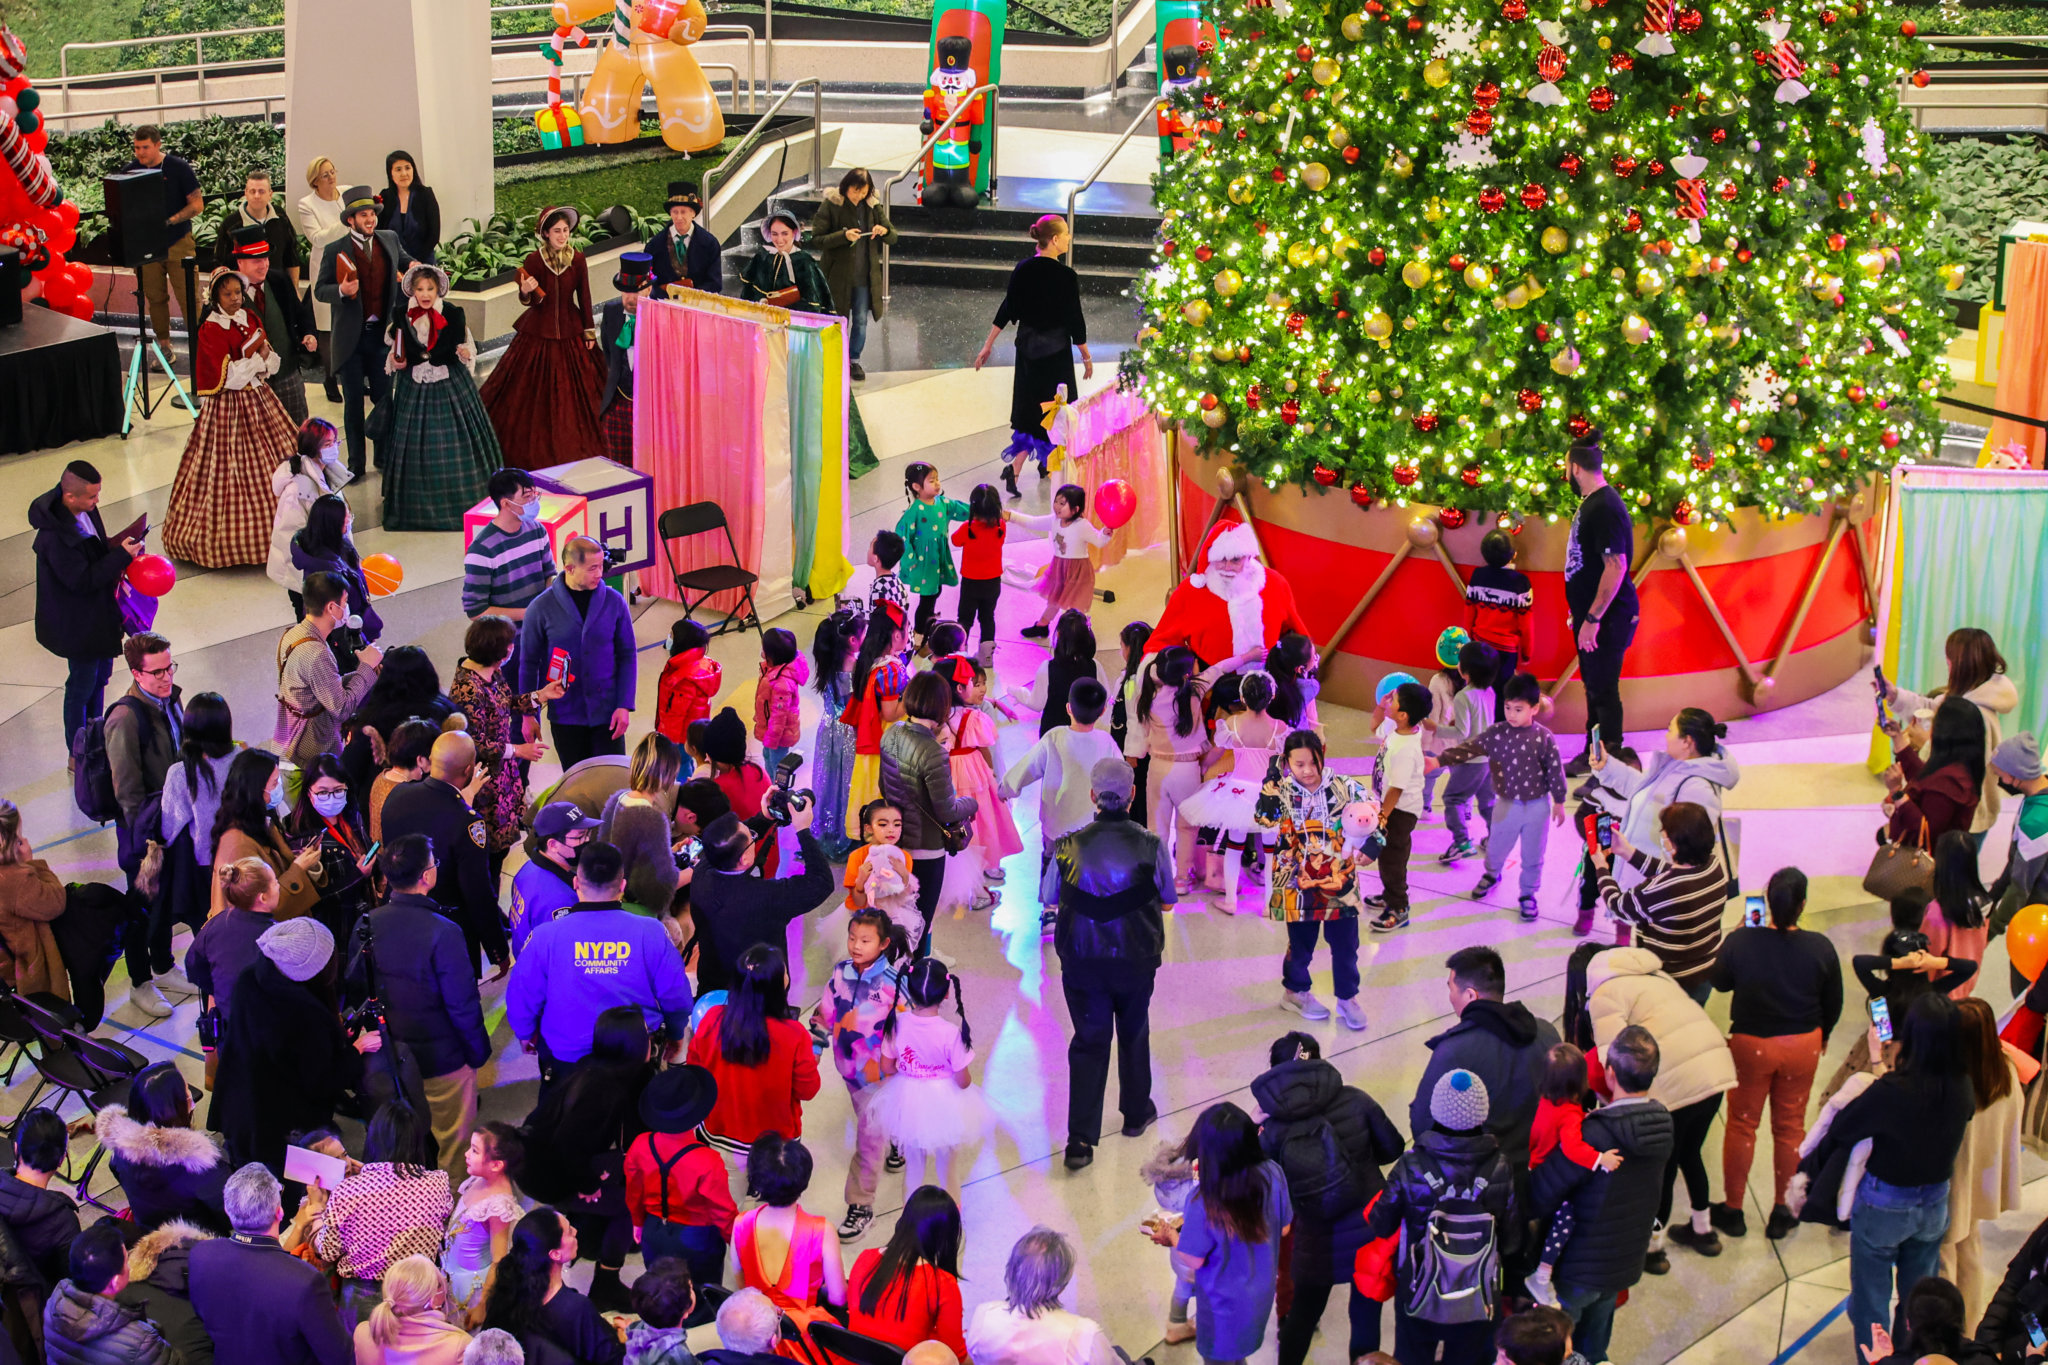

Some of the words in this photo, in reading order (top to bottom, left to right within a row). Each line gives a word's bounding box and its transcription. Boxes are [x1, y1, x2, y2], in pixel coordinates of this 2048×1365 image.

[600, 506, 633, 551] H
[574, 941, 631, 960] NYPD
[574, 959, 629, 967] COMMUNITY
[584, 966, 619, 974] AFFAIRS
